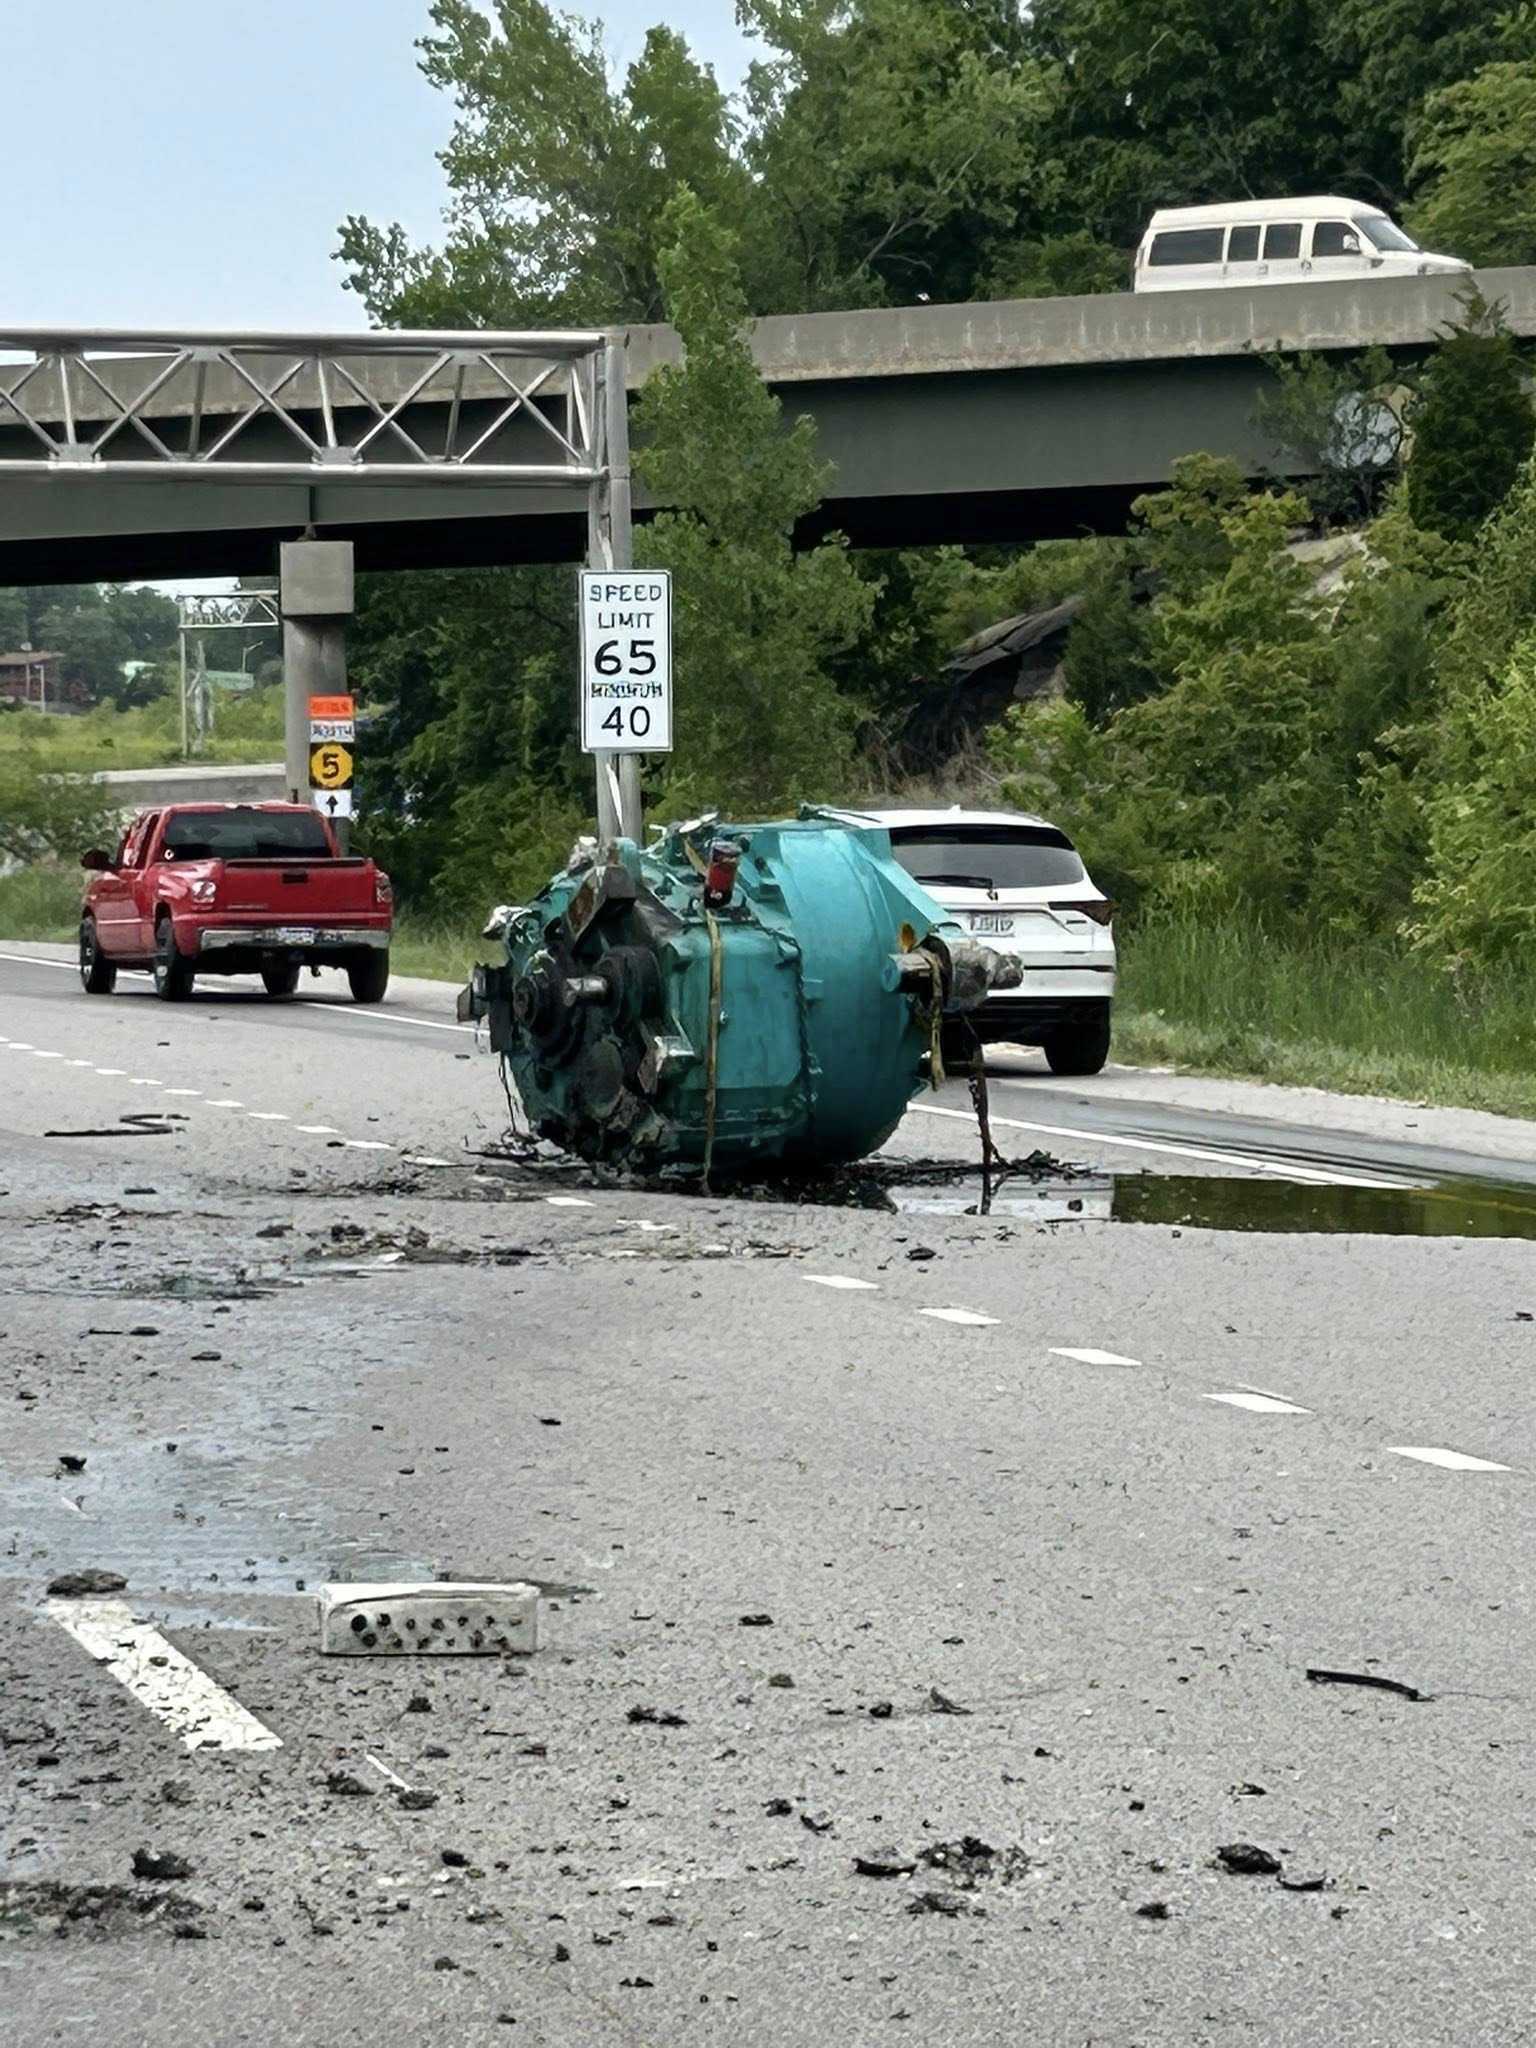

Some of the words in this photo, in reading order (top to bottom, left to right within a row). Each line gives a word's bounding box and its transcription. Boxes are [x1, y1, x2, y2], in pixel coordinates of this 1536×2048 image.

[590, 584, 662, 602] SPEED
[598, 612, 655, 629] LIMIT
[594, 639, 657, 676] 65
[601, 705, 651, 737] 40
[322, 751, 340, 779] 5
